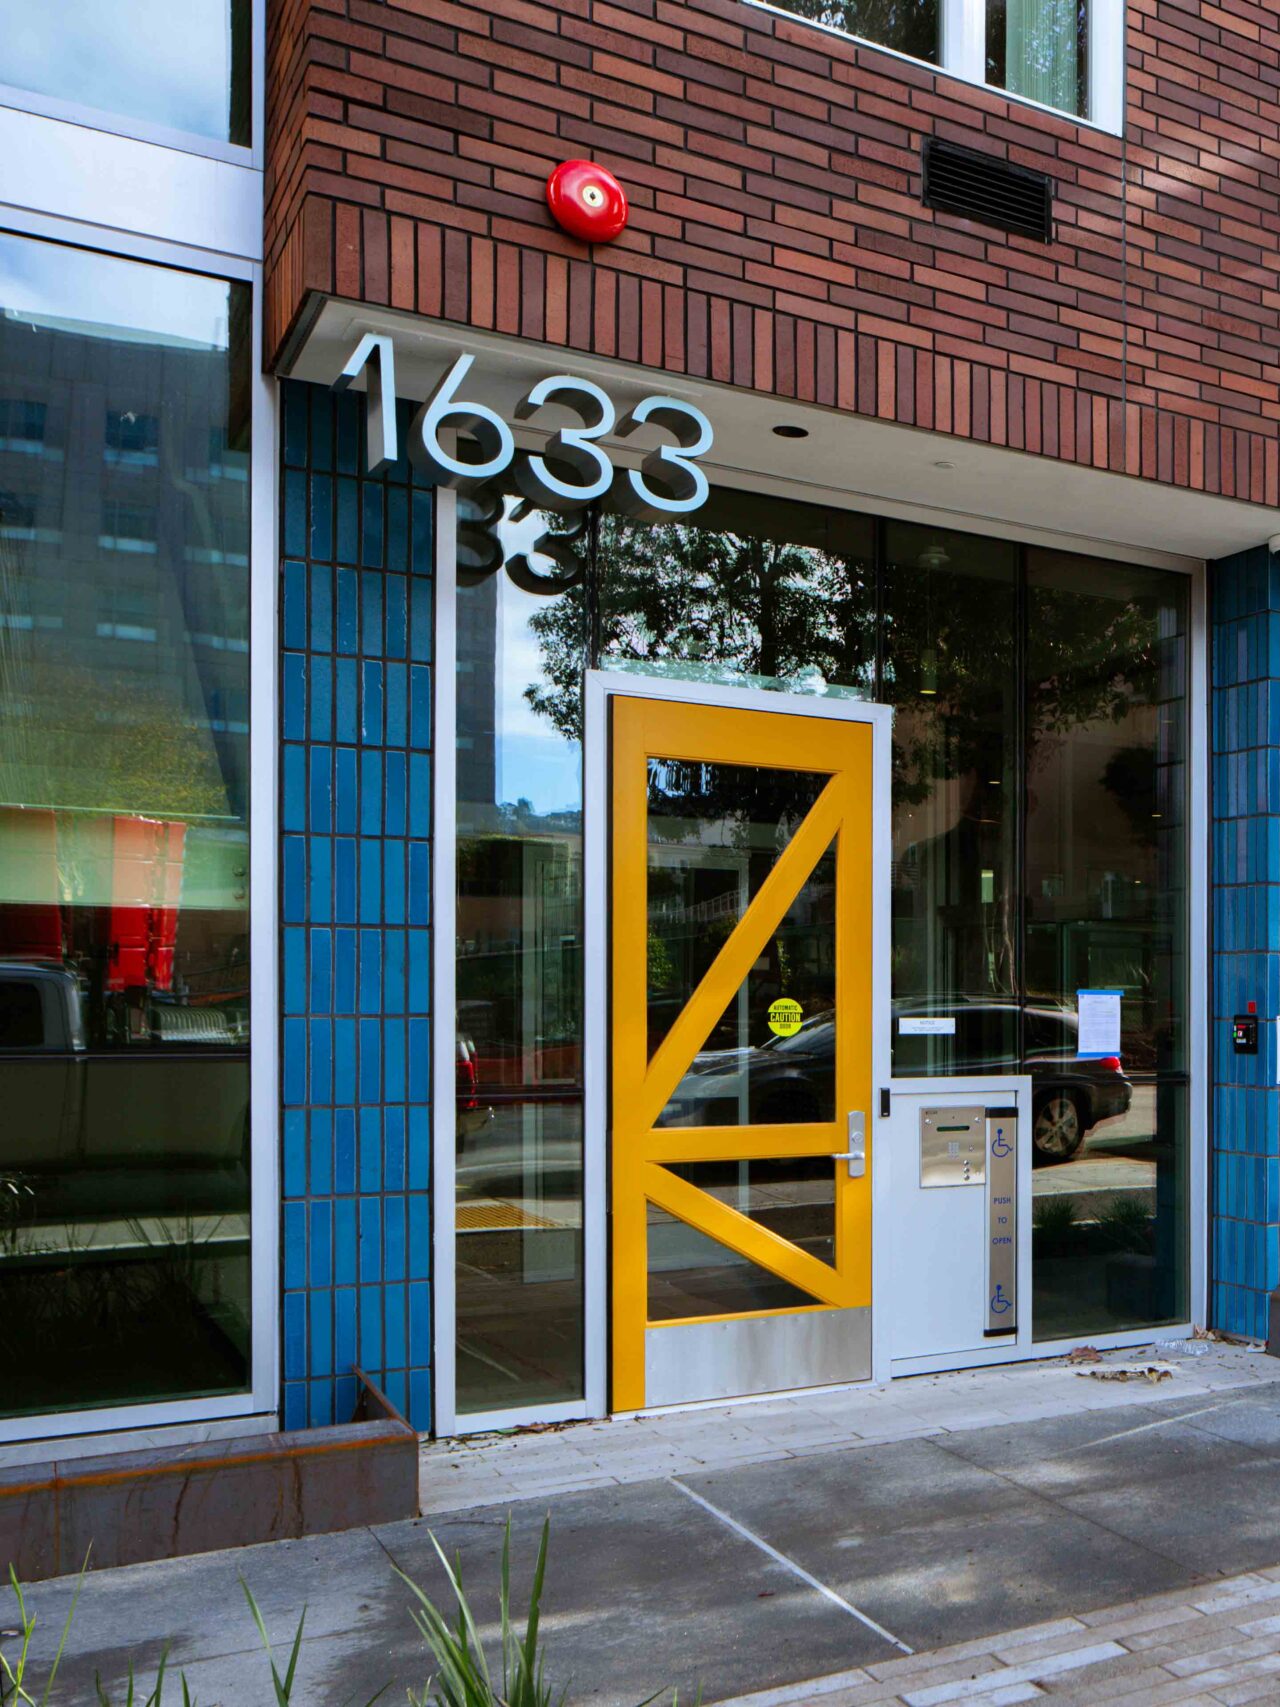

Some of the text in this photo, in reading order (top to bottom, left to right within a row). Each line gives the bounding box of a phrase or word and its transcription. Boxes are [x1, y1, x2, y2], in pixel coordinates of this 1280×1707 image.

[331, 333, 713, 513] 1633
[770, 1012, 801, 1022] CAUTION
[993, 1197, 1011, 1205] PUSH
[997, 1216, 1008, 1224] TO
[992, 1237, 1012, 1245] OPEN
